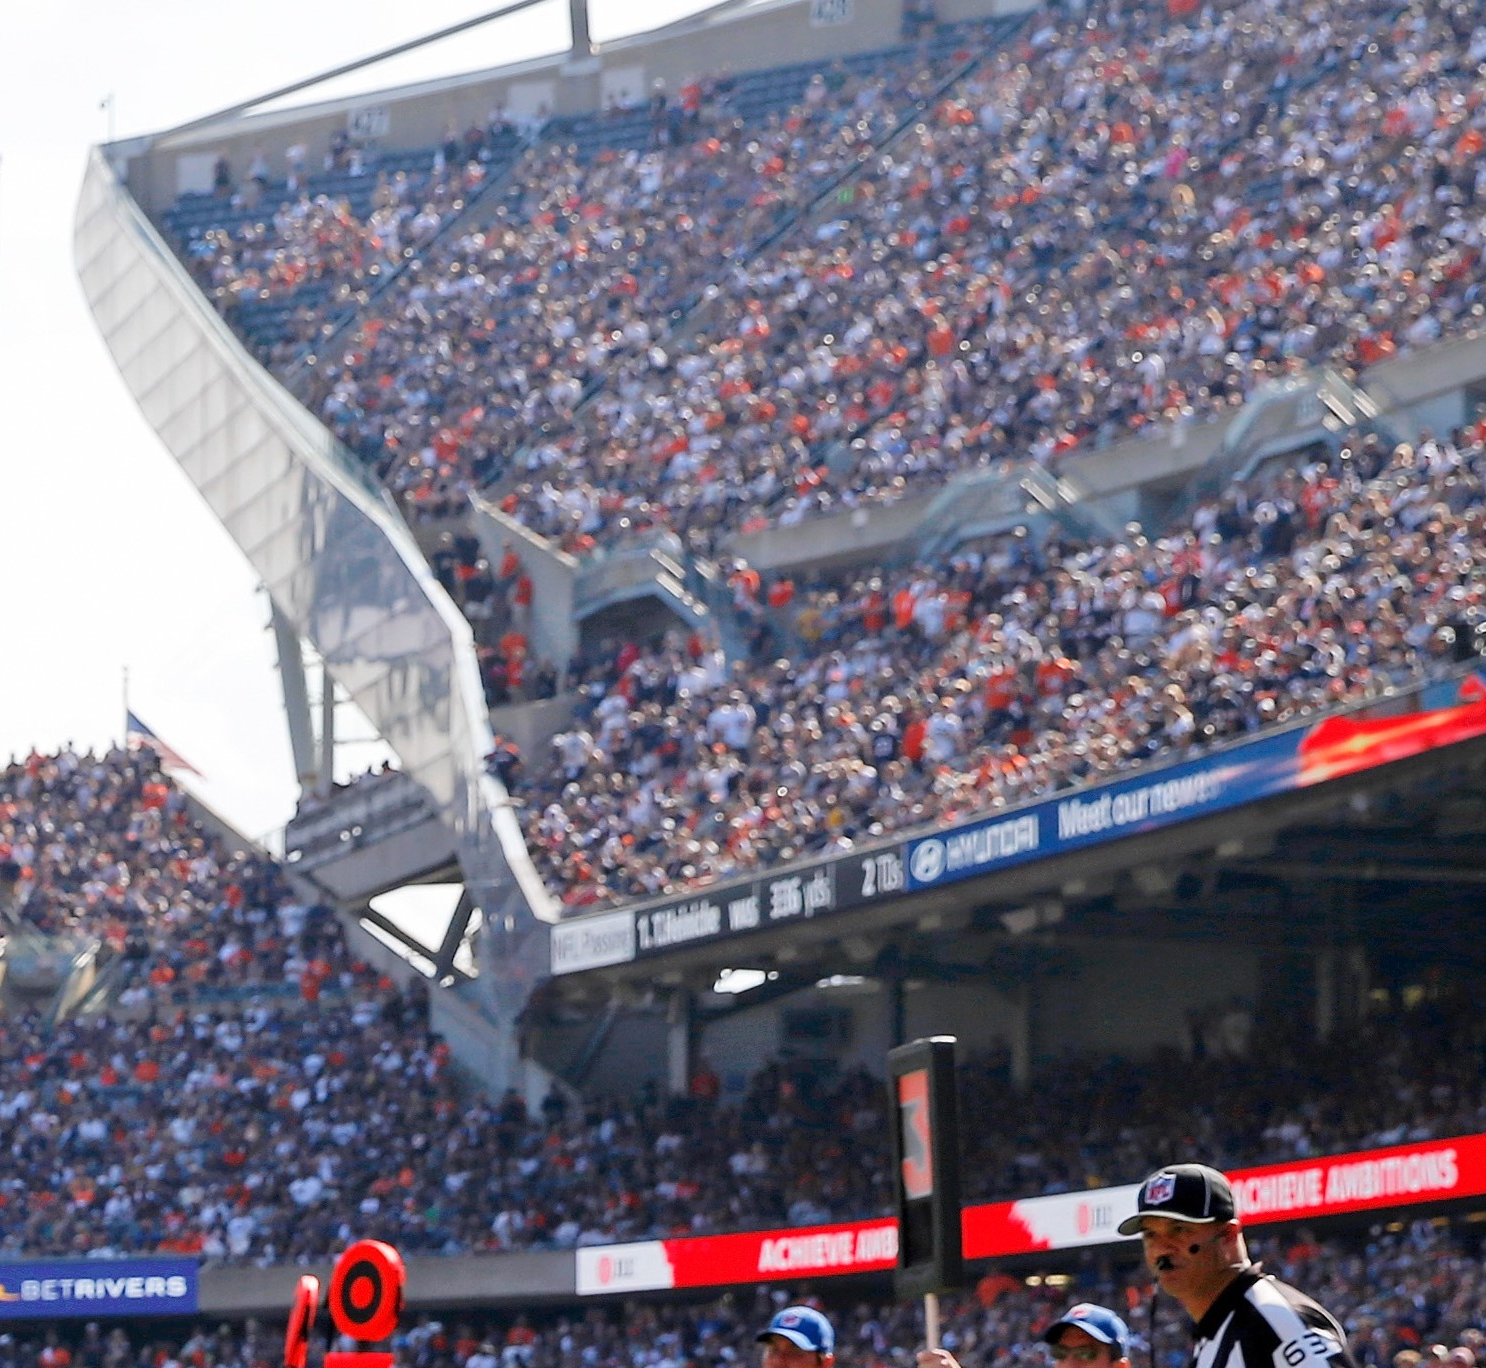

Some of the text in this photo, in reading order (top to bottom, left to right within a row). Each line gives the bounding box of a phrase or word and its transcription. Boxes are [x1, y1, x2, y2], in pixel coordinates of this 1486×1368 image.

[1058, 792, 1113, 841] Meet
[1327, 1148, 1459, 1199] AMBITIONS
[757, 1230, 855, 1273] ACHIEVE
[20, 1275, 188, 1302] BETRIVERS
[1282, 1331, 1328, 1367] 63
